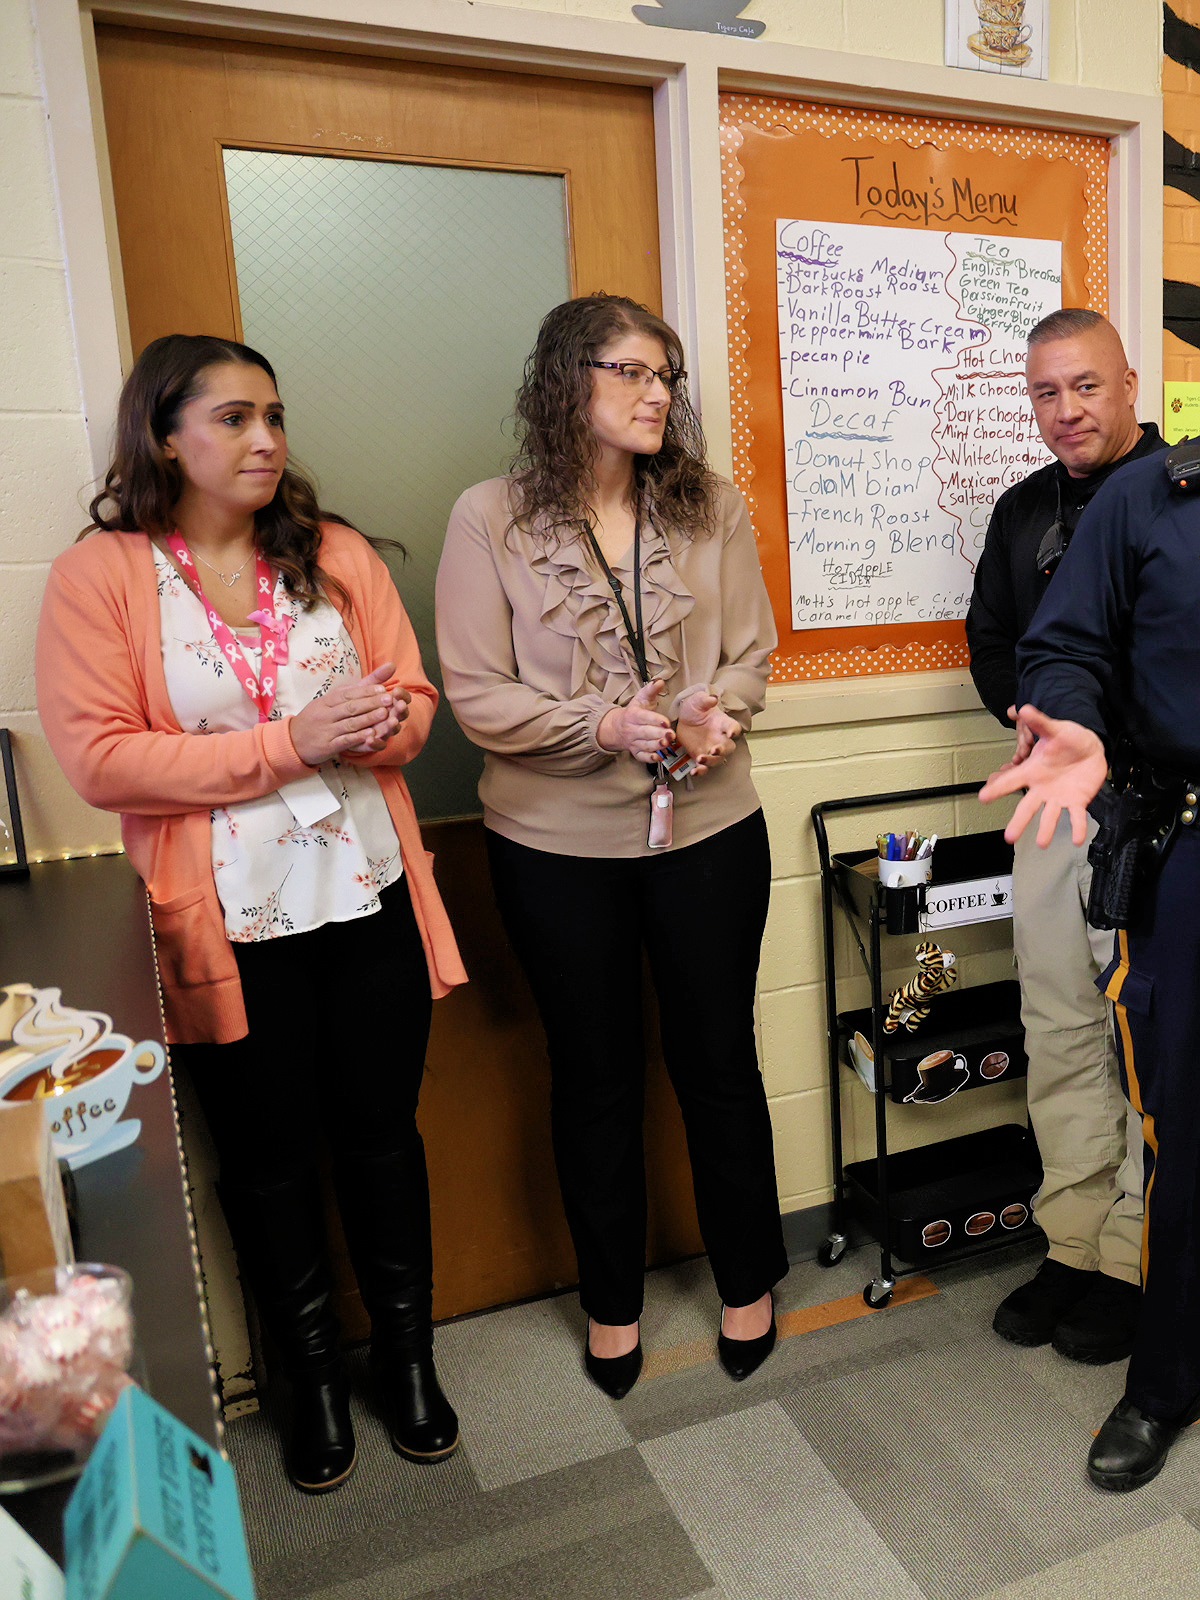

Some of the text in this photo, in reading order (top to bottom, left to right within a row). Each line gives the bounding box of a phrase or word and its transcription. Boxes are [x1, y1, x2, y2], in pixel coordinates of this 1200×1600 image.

[841, 156, 1018, 226] Today's Menu
[779, 220, 843, 259] Coffee
[974, 238, 1010, 258] Tea
[786, 262, 864, 283] Starbucks
[962, 258, 1010, 277] English
[786, 273, 882, 299] Dark Roast
[886, 274, 941, 295] Roast
[959, 273, 1029, 296] Green Tea
[787, 297, 986, 342] Vanilla Butter Cream
[967, 304, 1010, 319] Ginger
[898, 327, 956, 354] Bark
[963, 348, 1028, 368] Hot Choc
[789, 377, 931, 408] Cinnamon Bun
[809, 398, 900, 431] Decaf
[943, 400, 986, 425] Dark
[941, 424, 969, 442] Mint
[794, 439, 865, 472] Donut
[946, 471, 1000, 489] Mexican
[801, 499, 930, 532] French Roast
[796, 527, 876, 560] Morning
[889, 522, 956, 556] Blend
[795, 594, 834, 609] Mott's
[845, 594, 871, 610] hot
[877, 592, 920, 610] apple
[797, 608, 857, 622] Caramel
[865, 609, 903, 626] apple
[926, 893, 987, 915] COFFEE
[51, 1098, 116, 1138] offee
